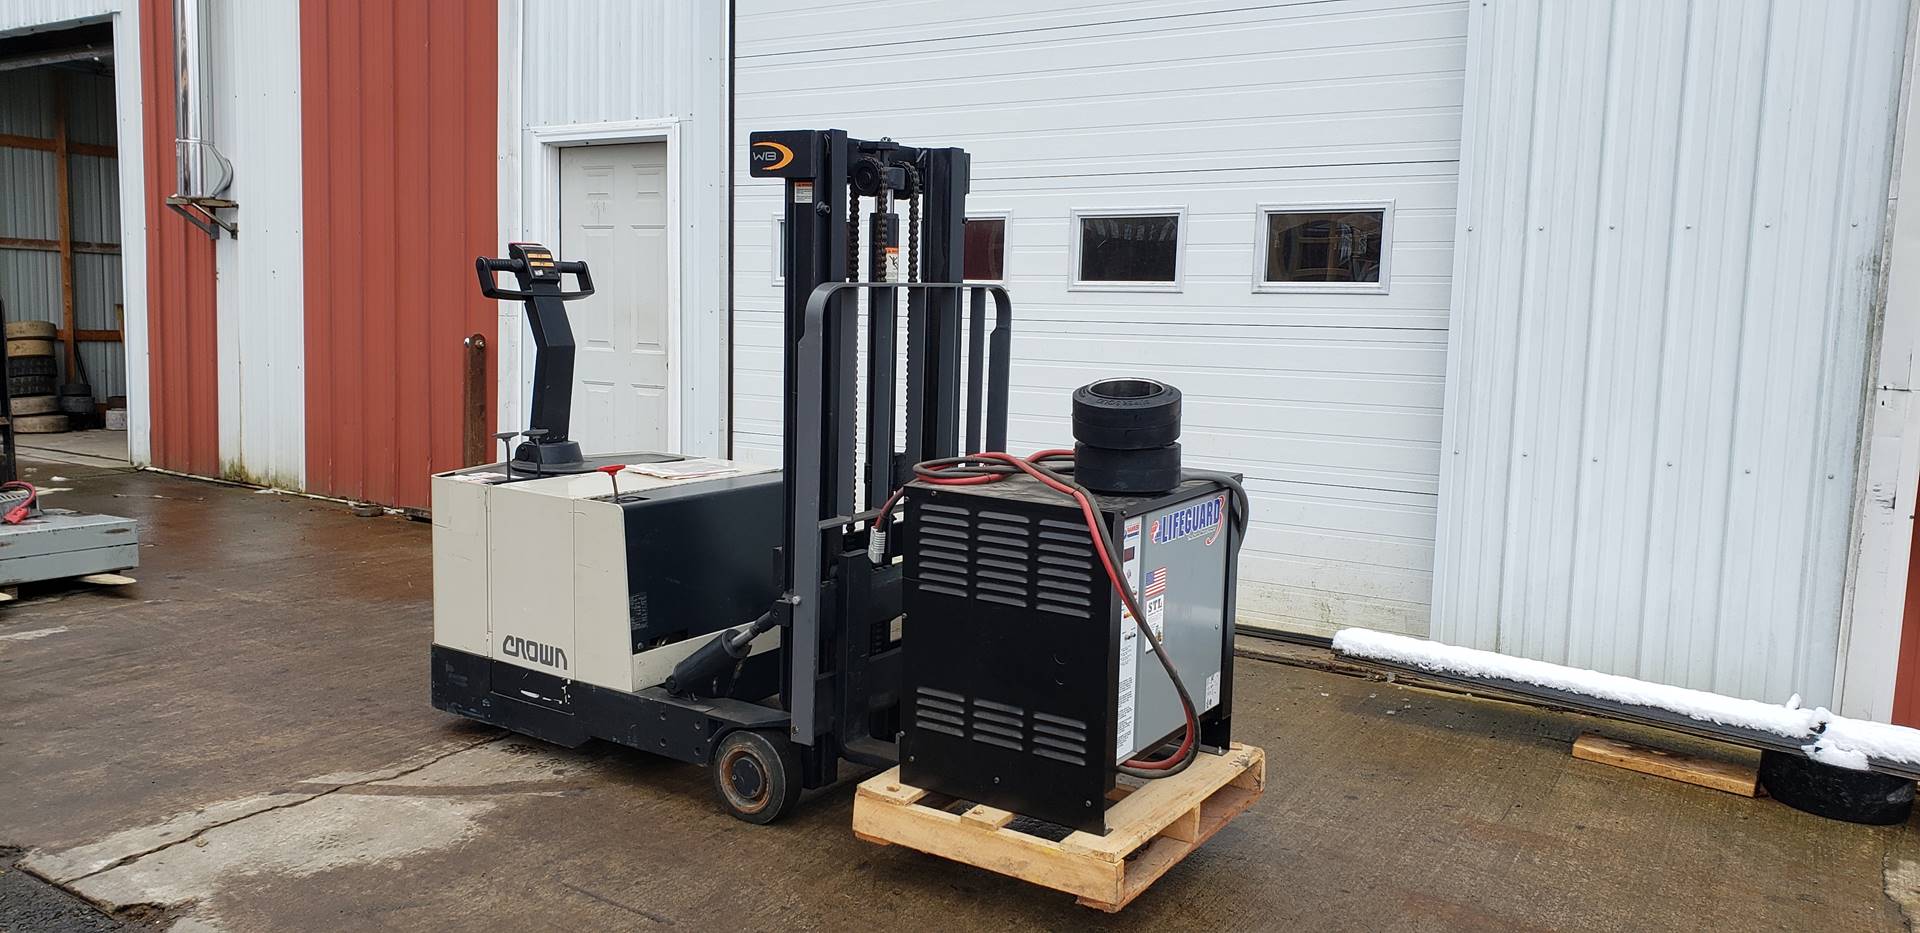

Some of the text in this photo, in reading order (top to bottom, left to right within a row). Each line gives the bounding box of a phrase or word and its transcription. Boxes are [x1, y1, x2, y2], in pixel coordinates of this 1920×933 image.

[752, 151, 777, 161] WB
[1160, 498, 1221, 543] LIFEGUARD
[1148, 598, 1162, 613] STL
[502, 634, 568, 671] CROWN
